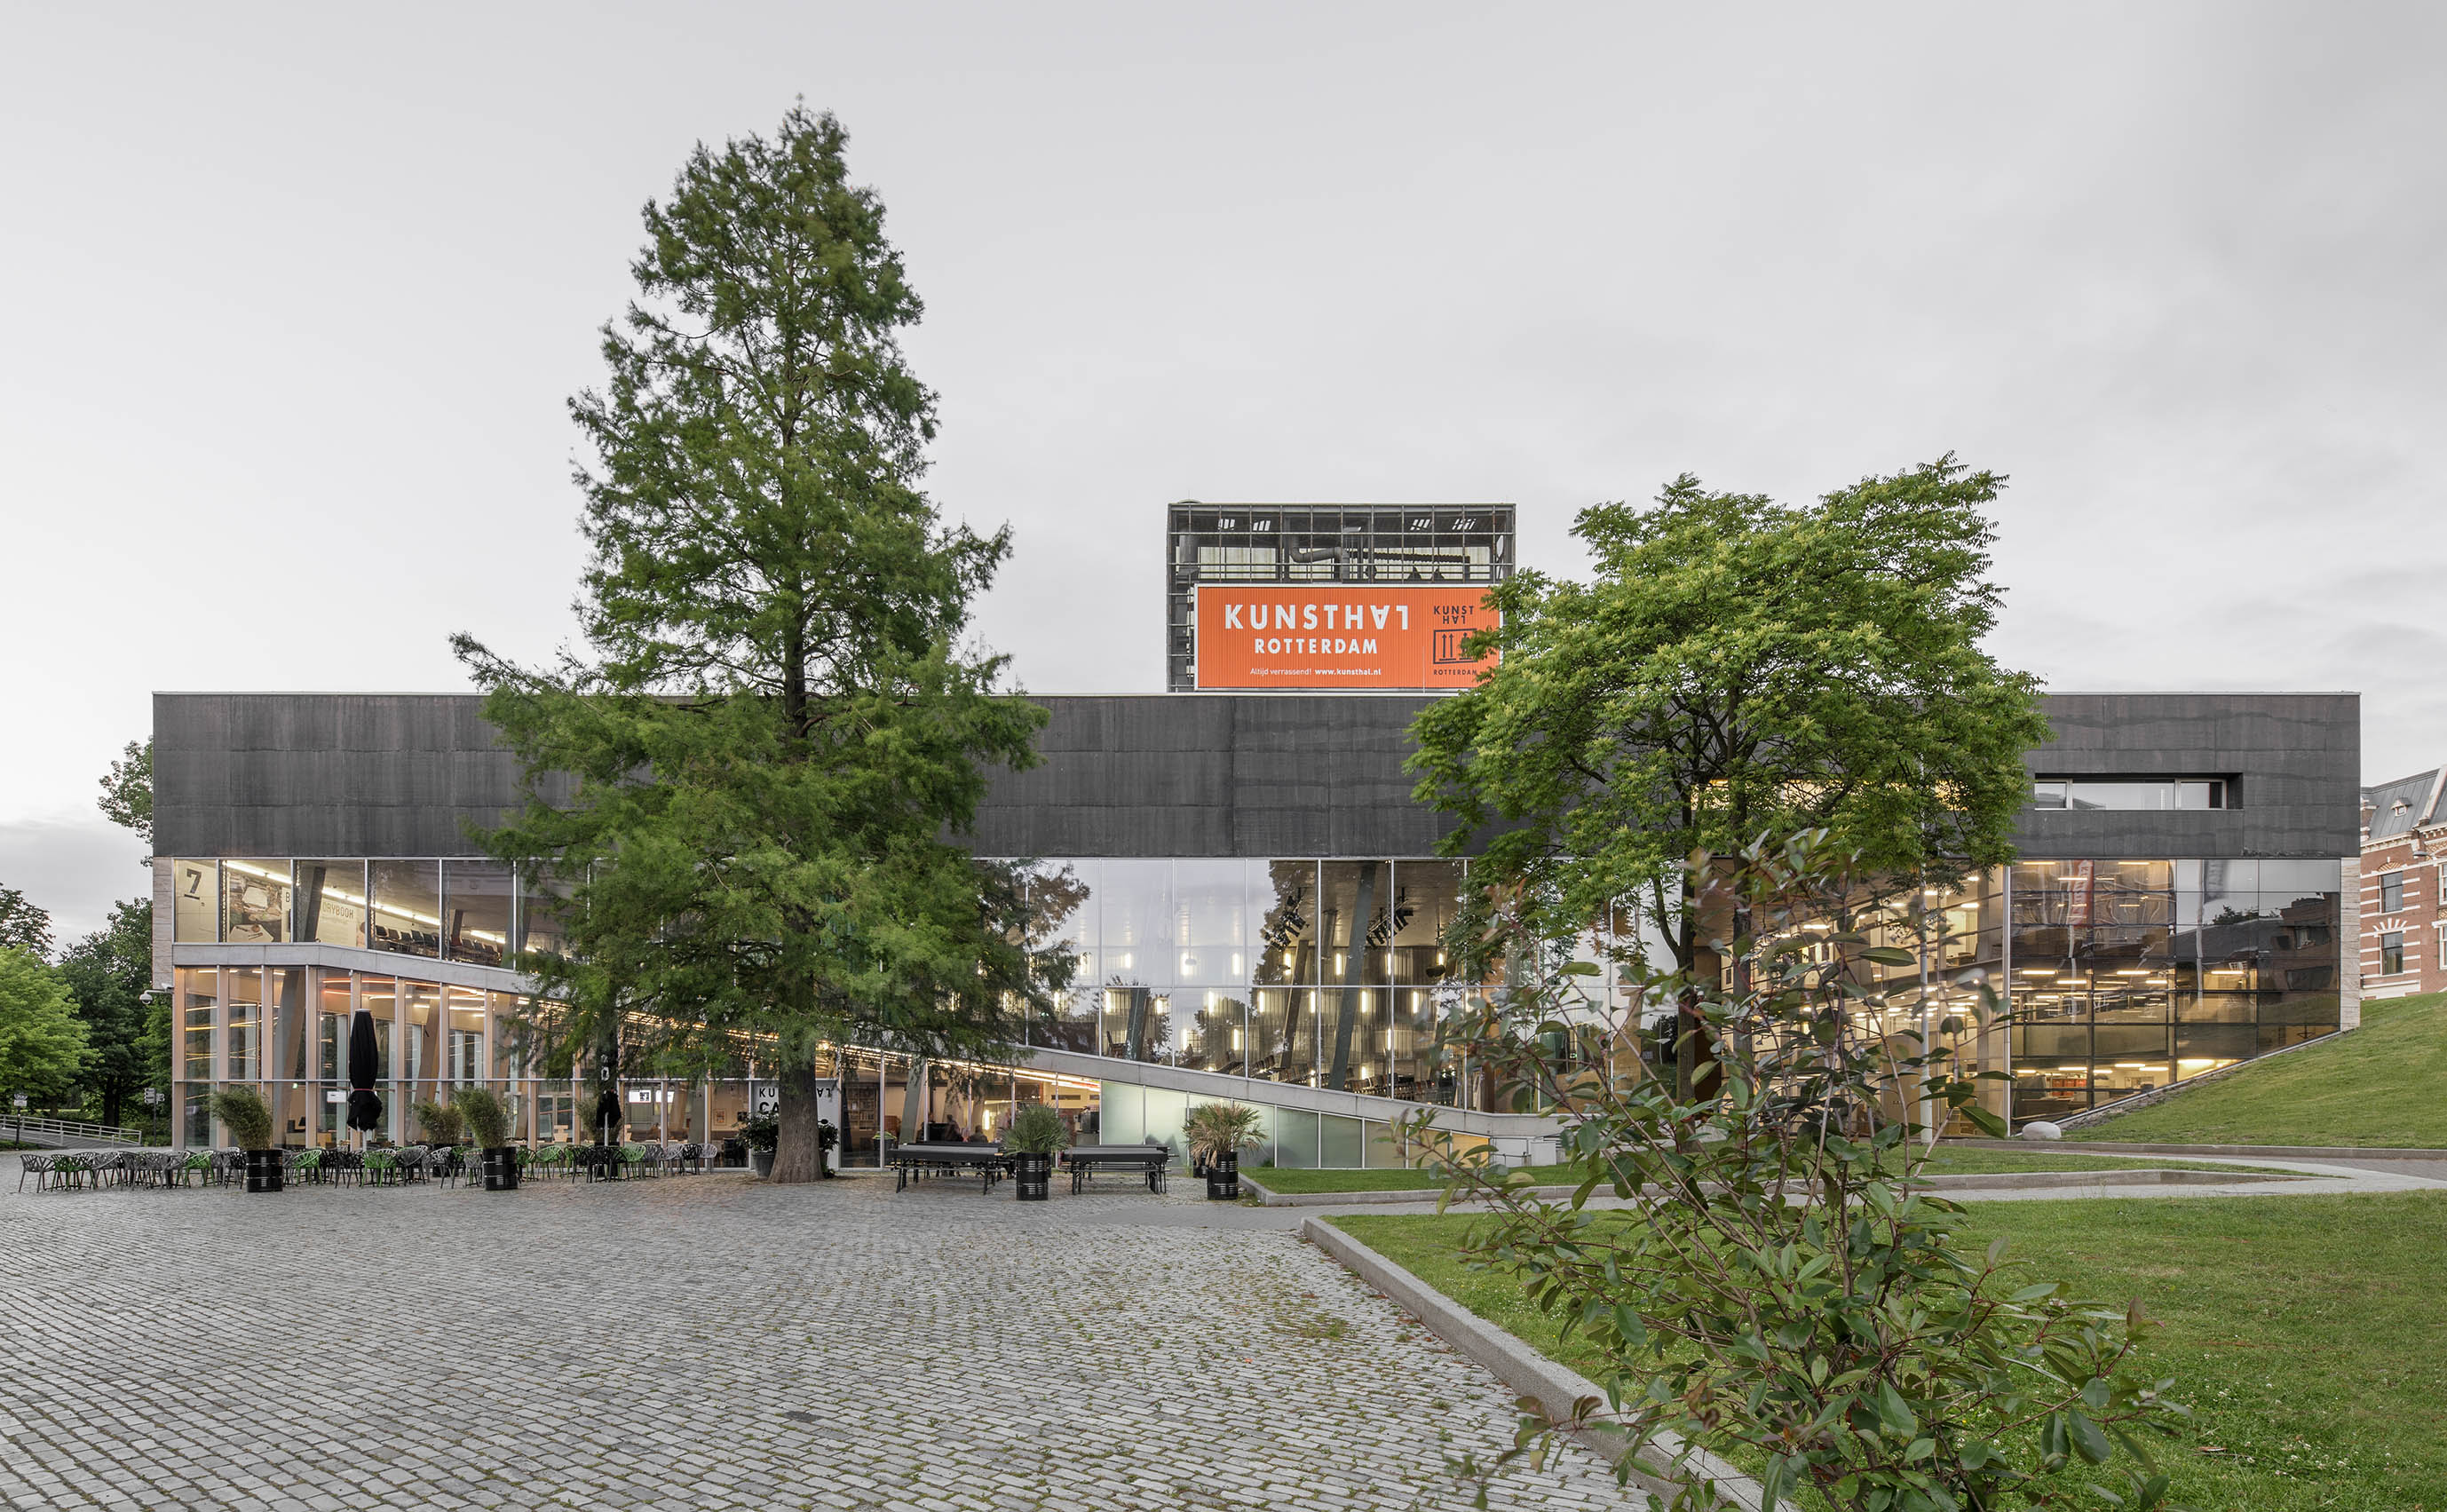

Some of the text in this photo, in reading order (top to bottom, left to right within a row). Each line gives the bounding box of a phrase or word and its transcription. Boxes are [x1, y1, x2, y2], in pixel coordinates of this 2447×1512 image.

[1434, 606, 1474, 614] KUNST
[1224, 604, 1409, 630] KUNSTHAL
[1442, 615, 1466, 624] HAL
[1255, 637, 1377, 654] ROTTERDAM
[1250, 668, 1269, 677] Altijd
[186, 868, 202, 894] 7
